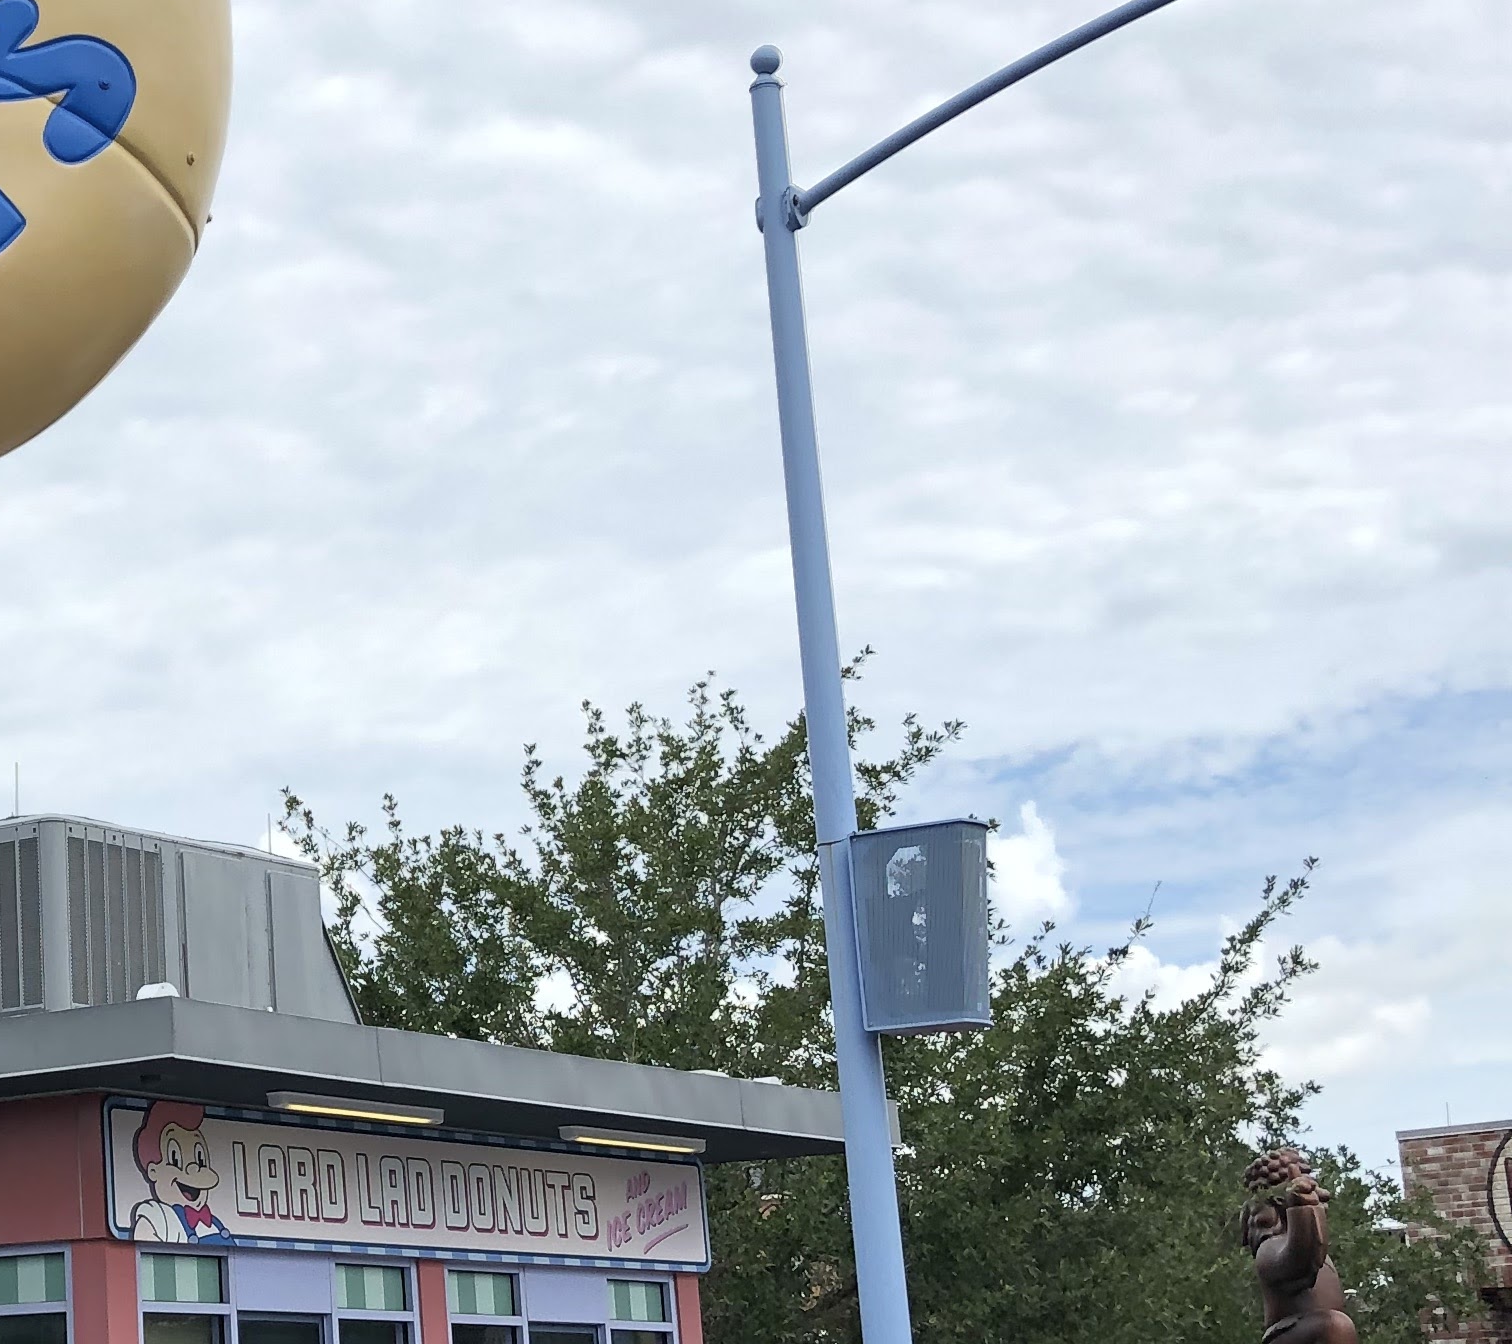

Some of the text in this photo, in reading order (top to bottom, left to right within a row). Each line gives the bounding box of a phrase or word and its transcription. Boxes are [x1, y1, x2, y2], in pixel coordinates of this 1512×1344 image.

[232, 1141, 599, 1240] LARD LAD DONUTS
[607, 1181, 688, 1252] ICE CREAM
[626, 1170, 650, 1203] AND
